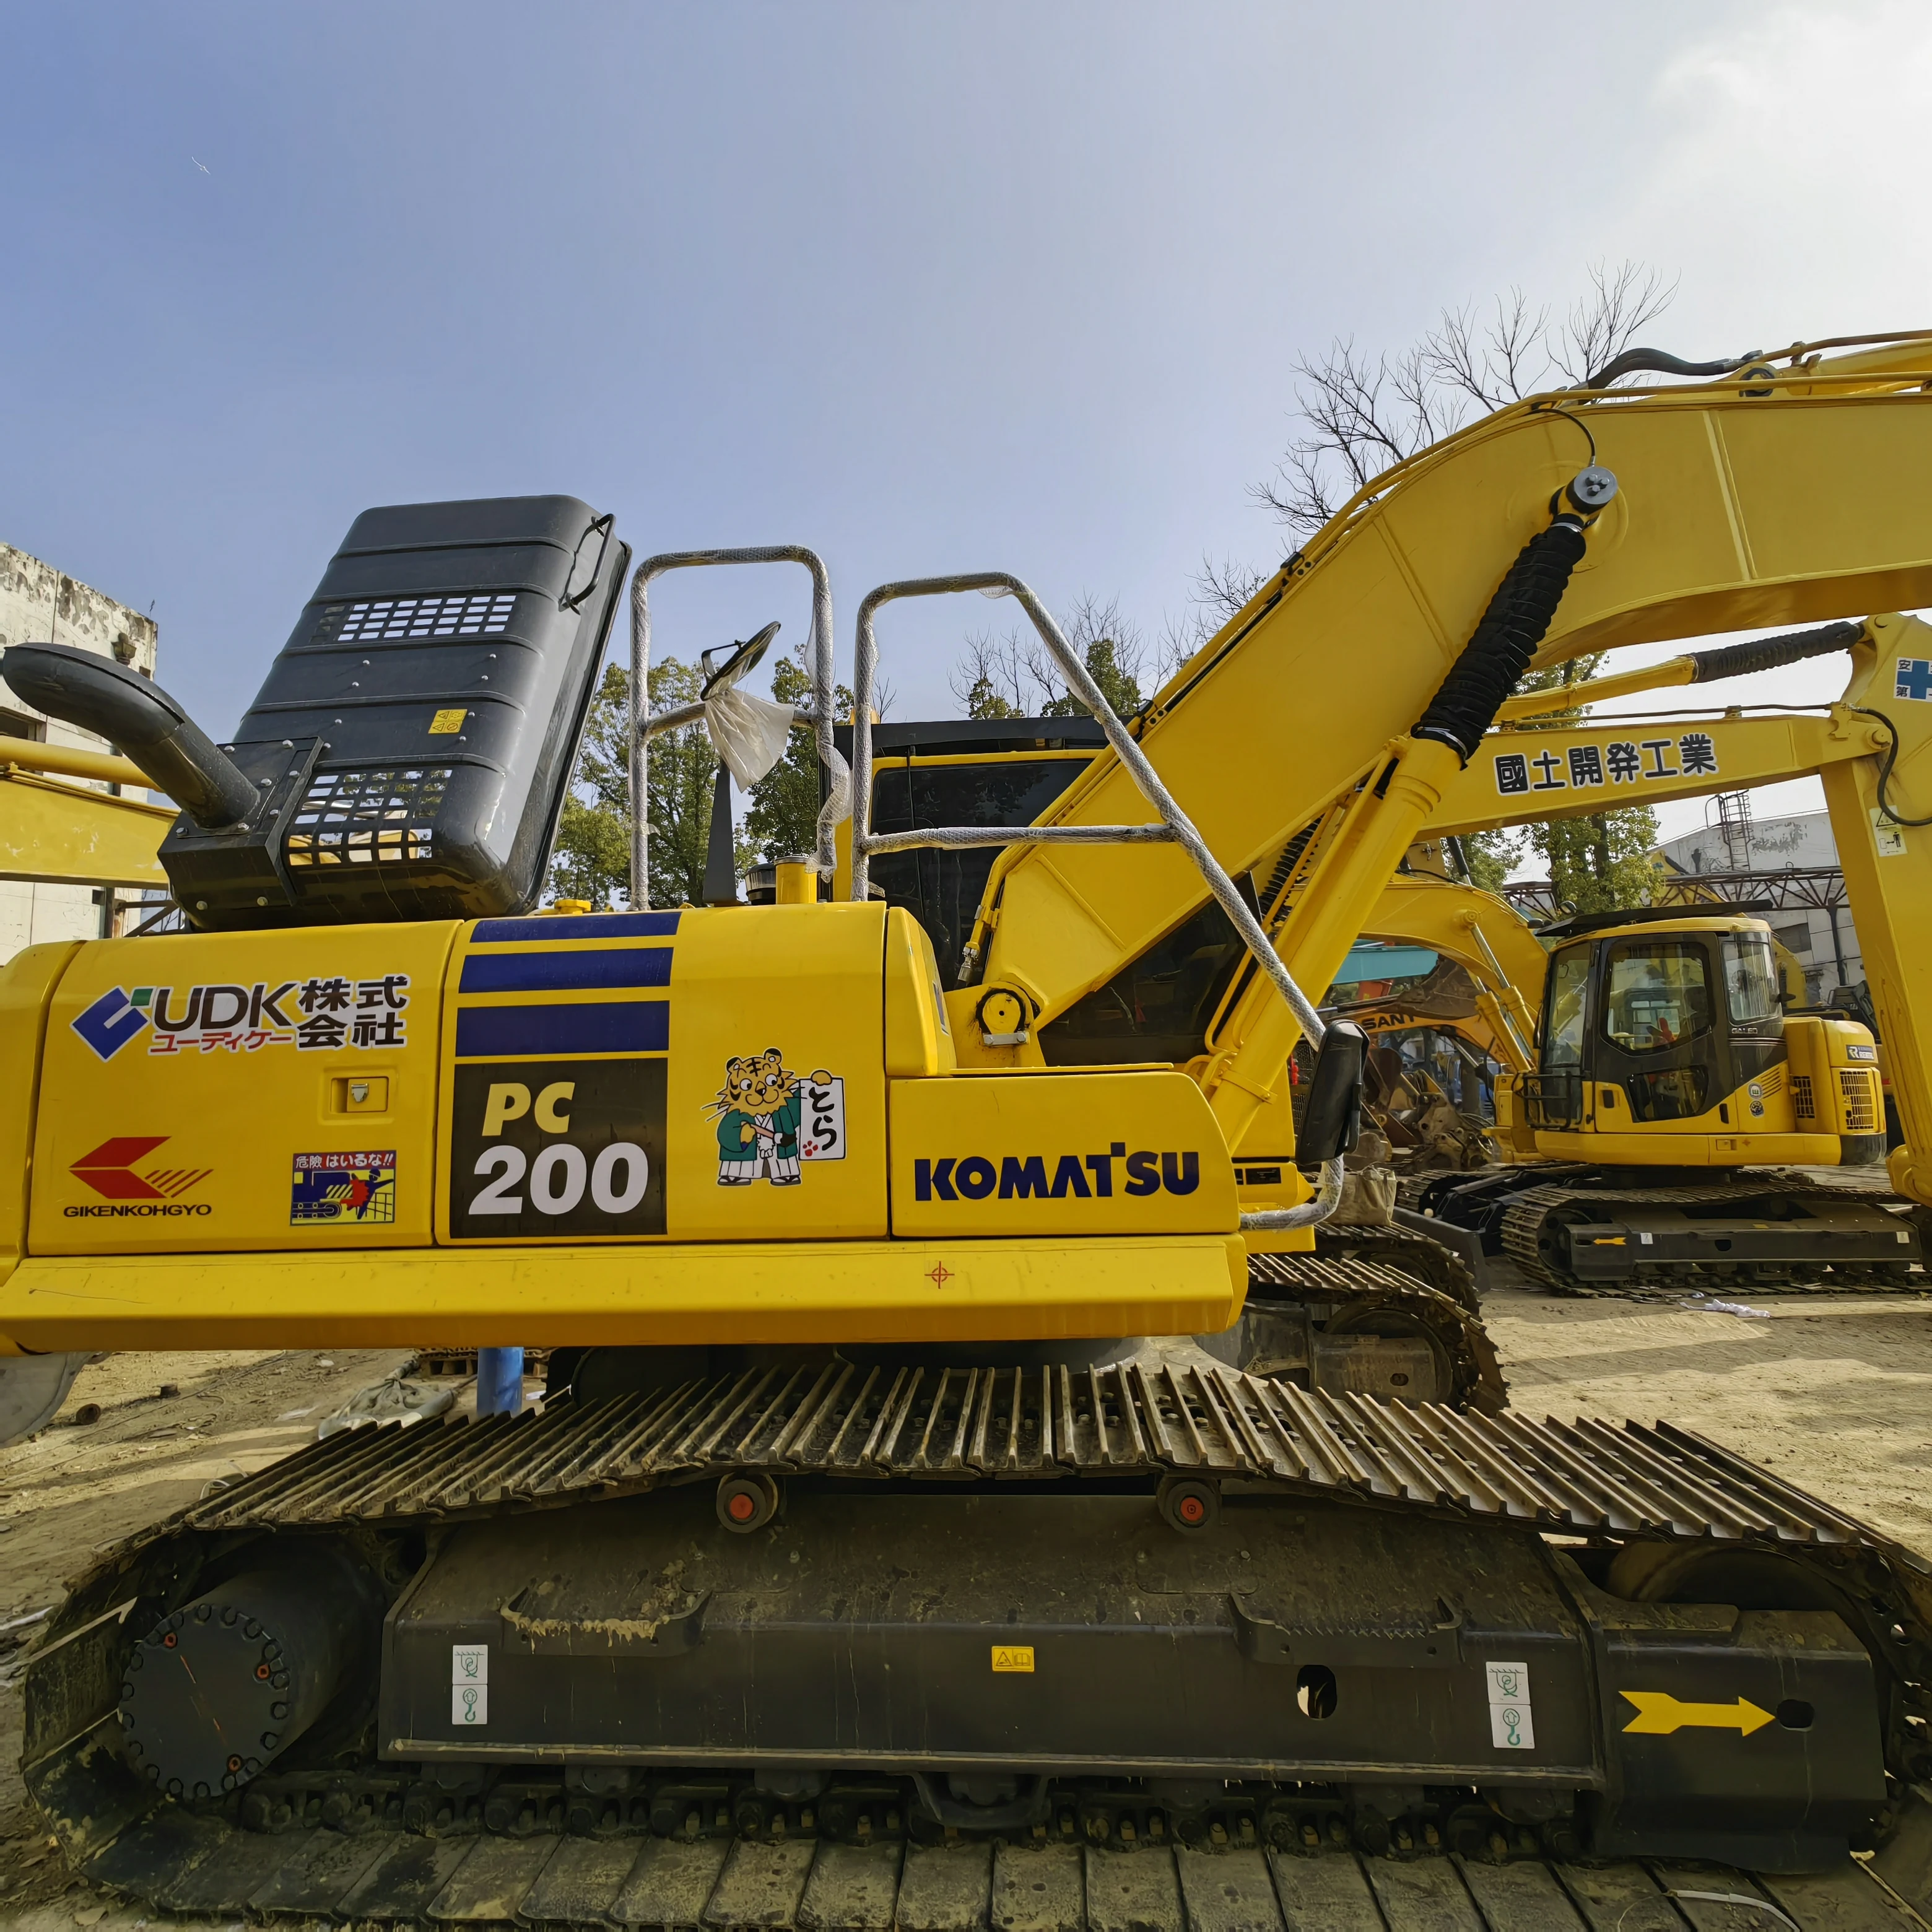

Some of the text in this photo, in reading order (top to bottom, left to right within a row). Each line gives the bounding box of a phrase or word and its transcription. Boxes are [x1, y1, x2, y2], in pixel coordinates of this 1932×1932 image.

[1495, 733, 1717, 793] 國土開発工業
[154, 983, 297, 1032] UDK
[150, 1030, 292, 1053] ユーディケー
[482, 1082, 575, 1136] PC
[808, 1086, 837, 1151] とら
[468, 1142, 649, 1215] 200
[914, 1142, 1200, 1201] KOMATSU
[63, 1204, 212, 1217] GIKENKOHGYO
